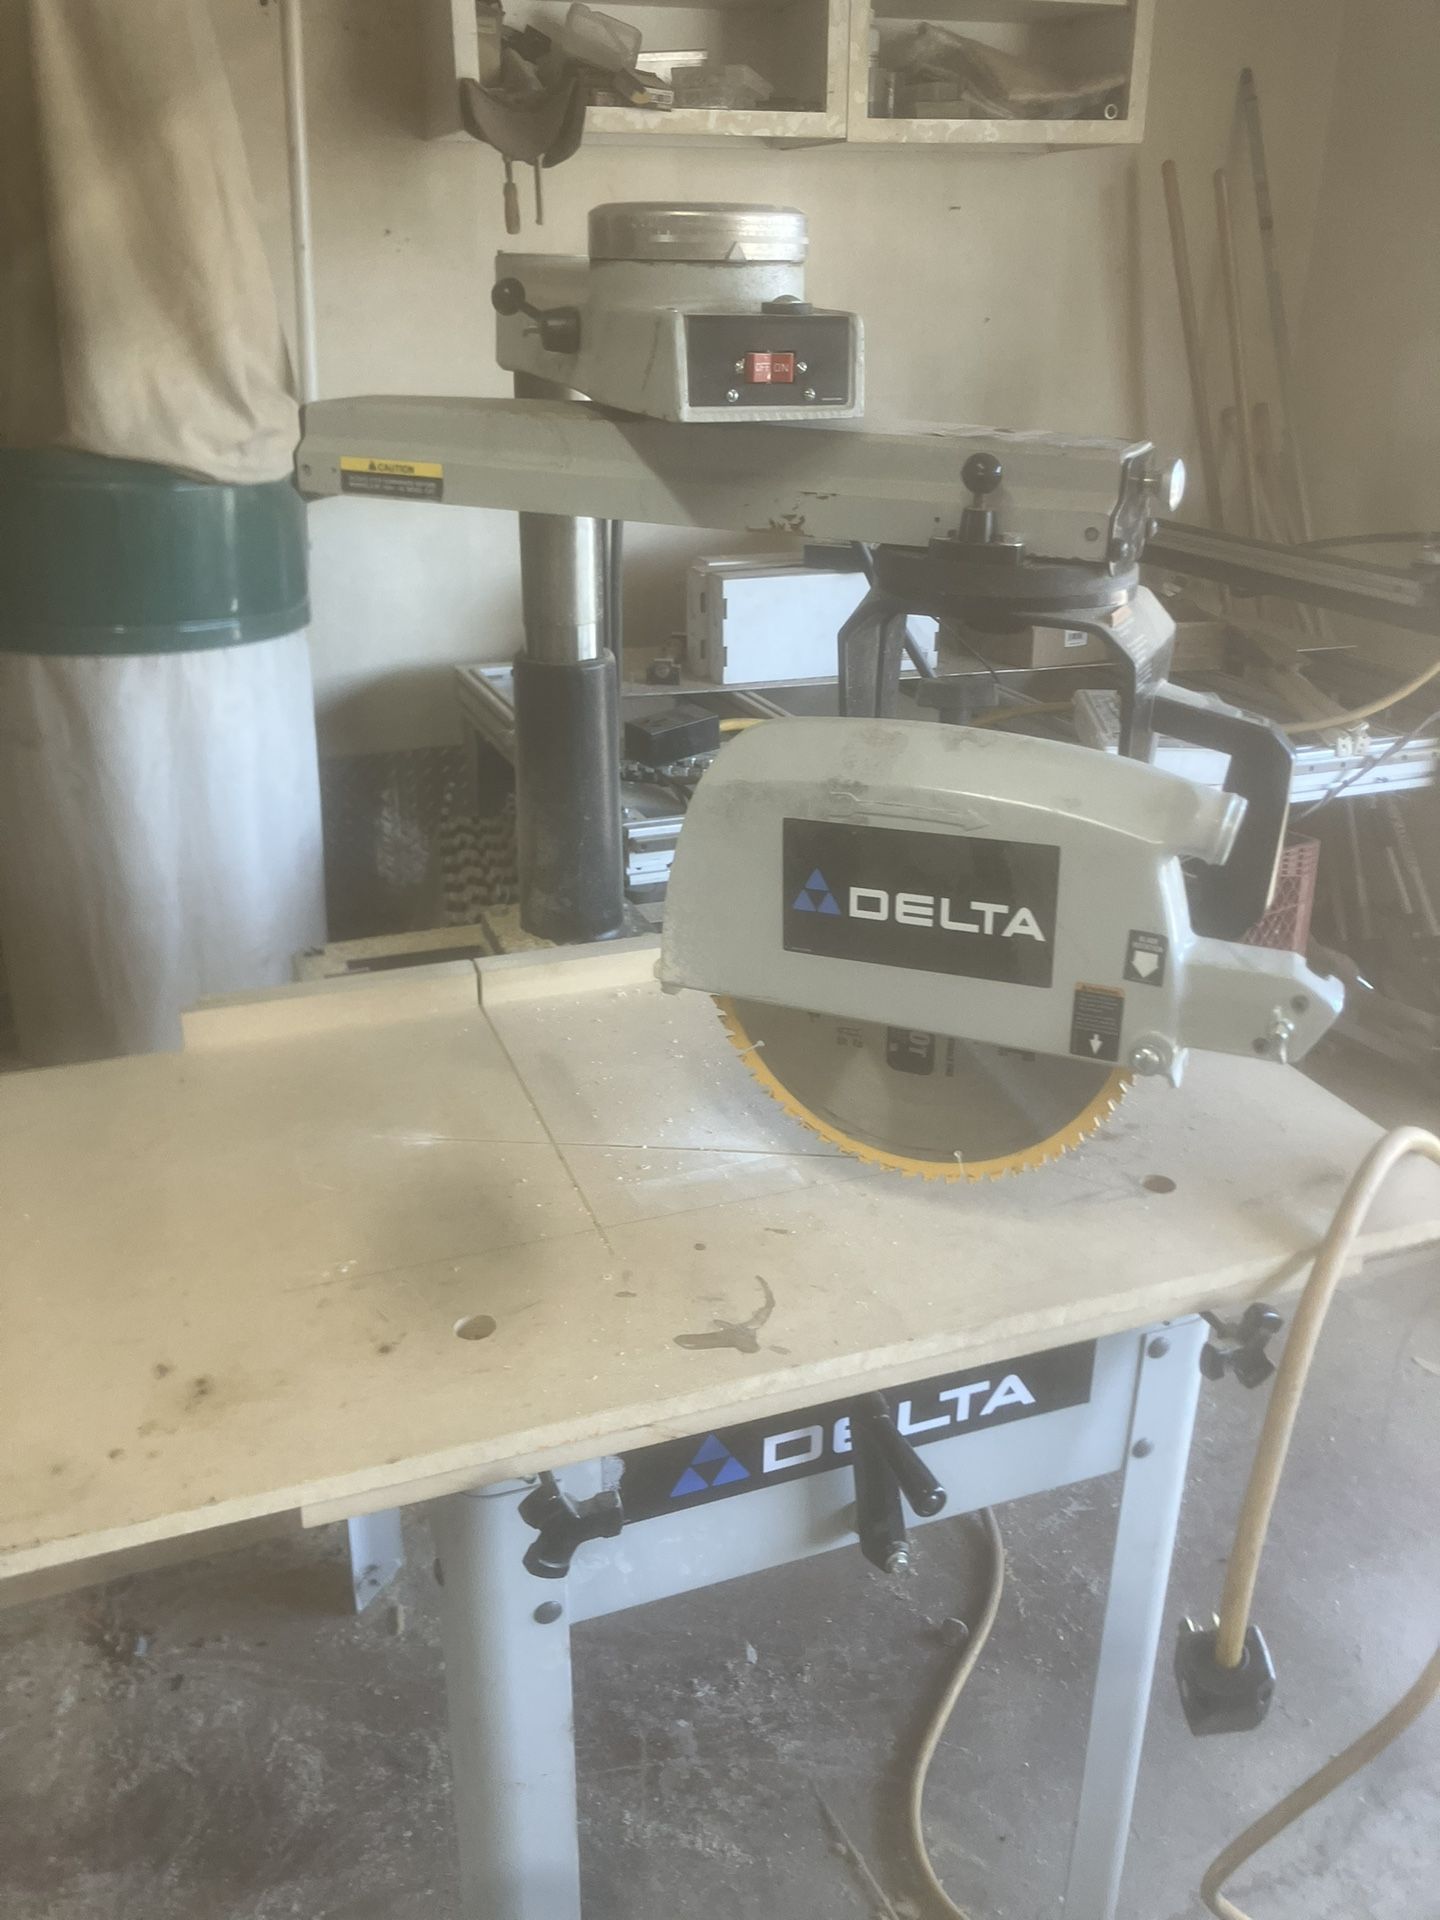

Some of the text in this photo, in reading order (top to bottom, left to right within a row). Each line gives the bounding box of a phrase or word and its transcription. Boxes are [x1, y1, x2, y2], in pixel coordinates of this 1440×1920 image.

[755, 362, 789, 373] OFF ON
[849, 886, 1046, 942] DELTA
